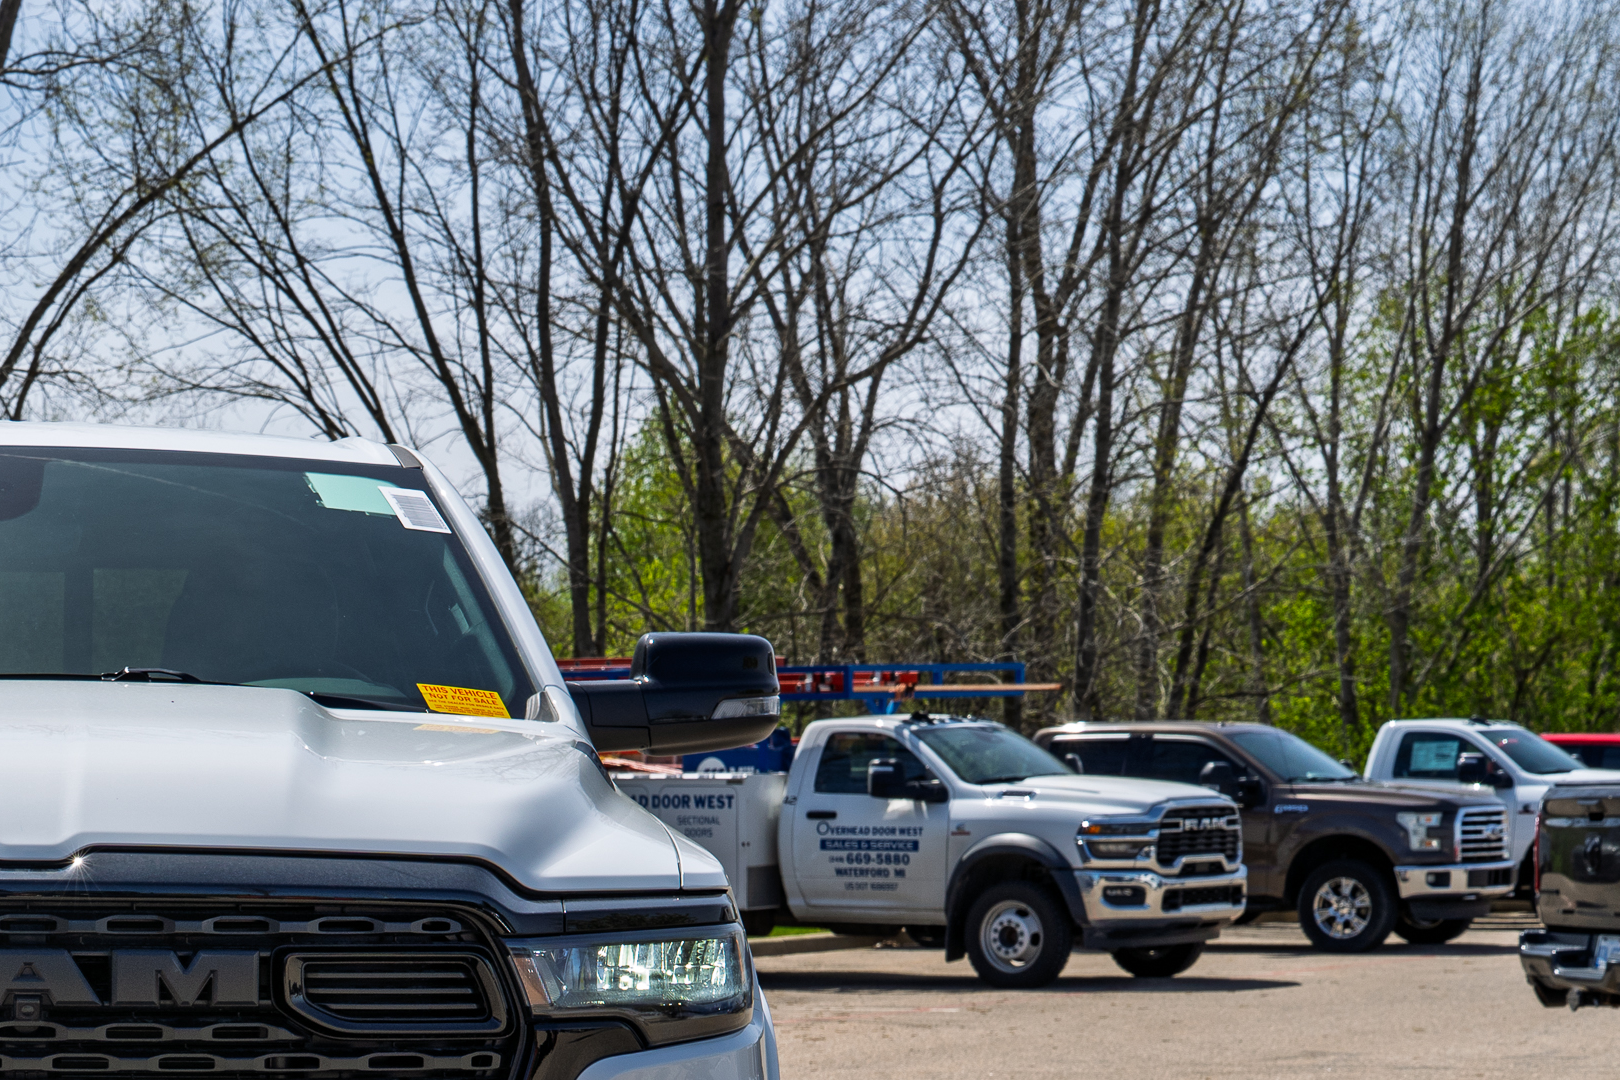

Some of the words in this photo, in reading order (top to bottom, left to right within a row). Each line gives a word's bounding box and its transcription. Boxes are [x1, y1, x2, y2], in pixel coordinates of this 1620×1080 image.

[422, 685, 448, 694] THIS
[450, 687, 497, 700] VEHICLE
[474, 697, 499, 706] SALE
[651, 794, 692, 809] DOOR
[693, 794, 735, 809] WEST
[677, 815, 720, 826] SECTIONAL
[1184, 816, 1228, 831] RAM
[684, 827, 713, 839] DOORS
[816, 821, 871, 836] OVERHEAD
[872, 826, 897, 837] DOOR
[898, 826, 924, 837] WEST
[825, 840, 858, 850] SALES
[870, 841, 915, 850] SERVICE
[846, 852, 910, 866] 669-5880
[834, 867, 890, 878] WATERFORD
[894, 868, 906, 878] MI
